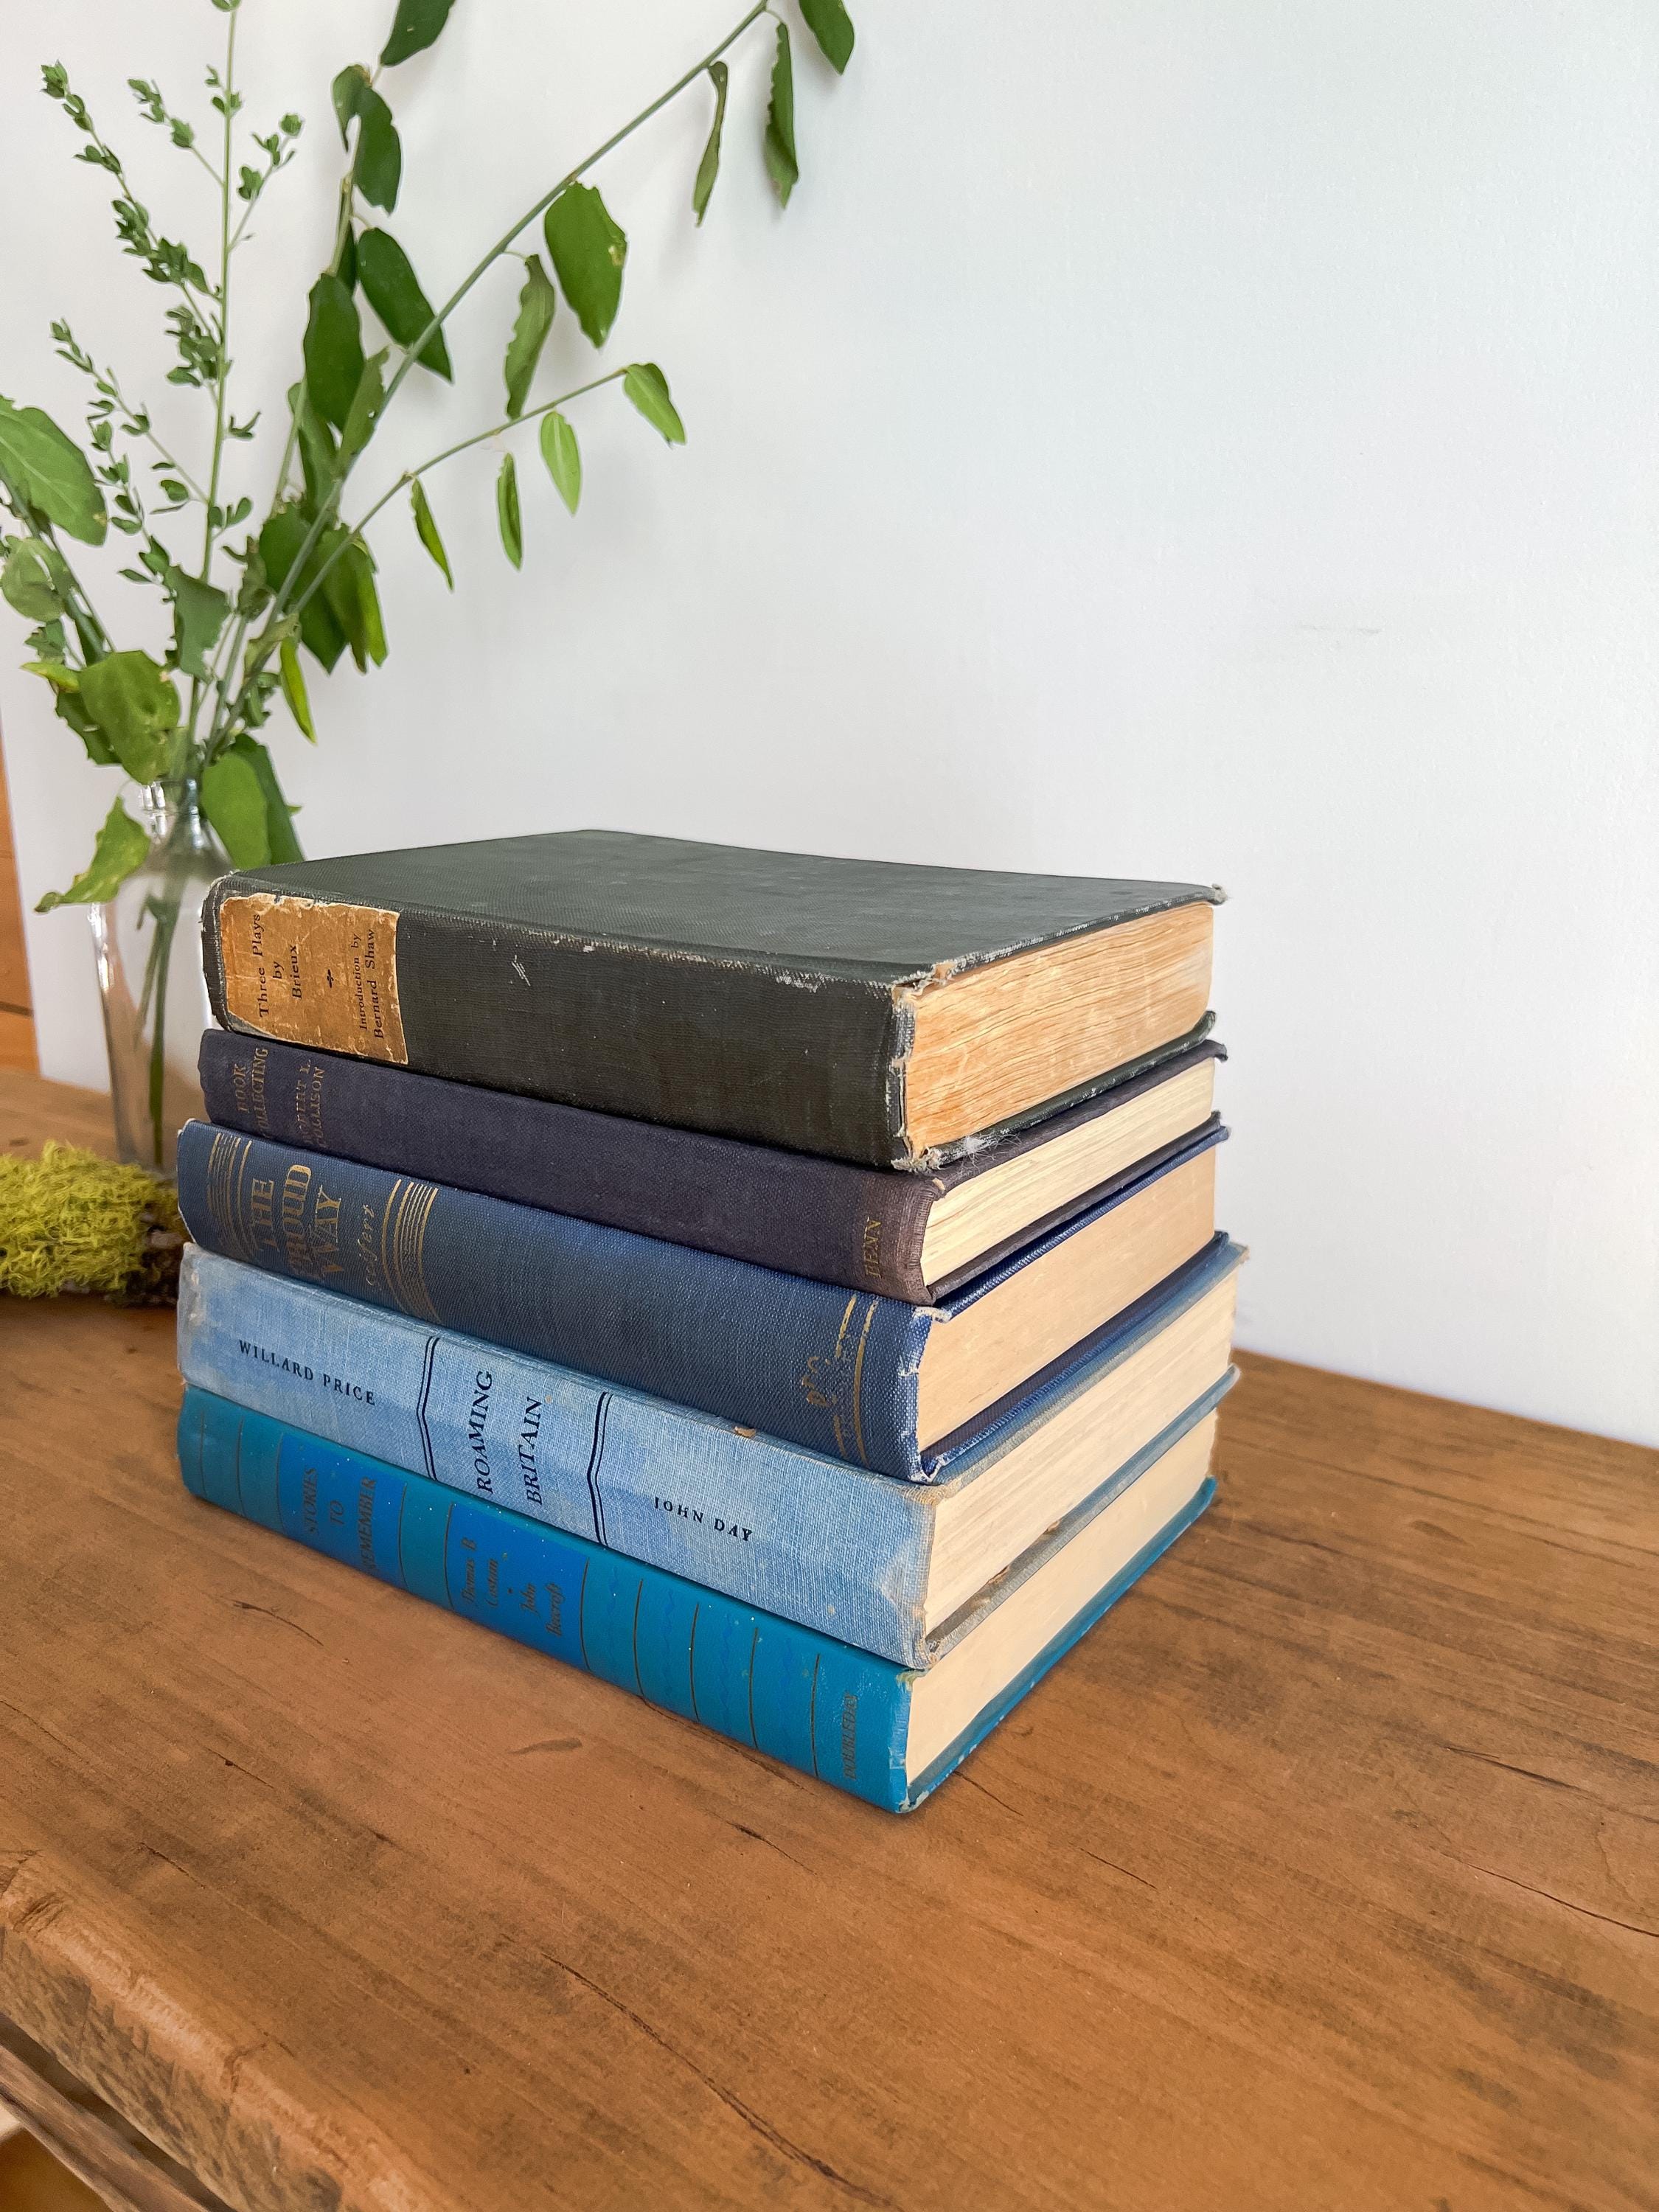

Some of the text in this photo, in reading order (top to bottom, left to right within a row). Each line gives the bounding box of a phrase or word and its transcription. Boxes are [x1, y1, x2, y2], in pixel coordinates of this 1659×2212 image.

[251, 914, 269, 1018] Three Plays
[272, 961, 284, 979] by
[290, 945, 302, 1000] Brieux
[351, 933, 368, 1031] Introduction by
[364, 928, 384, 1040] Bernard Shaw
[282, 1164, 319, 1277] ROUD
[239, 1339, 375, 1406] WILLARD PRICE
[469, 1371, 494, 1495] ROAMING
[518, 1397, 543, 1505] BRITAIN
[330, 1500, 345, 1526] TO
[654, 1496, 753, 1542] JOHN DAY
